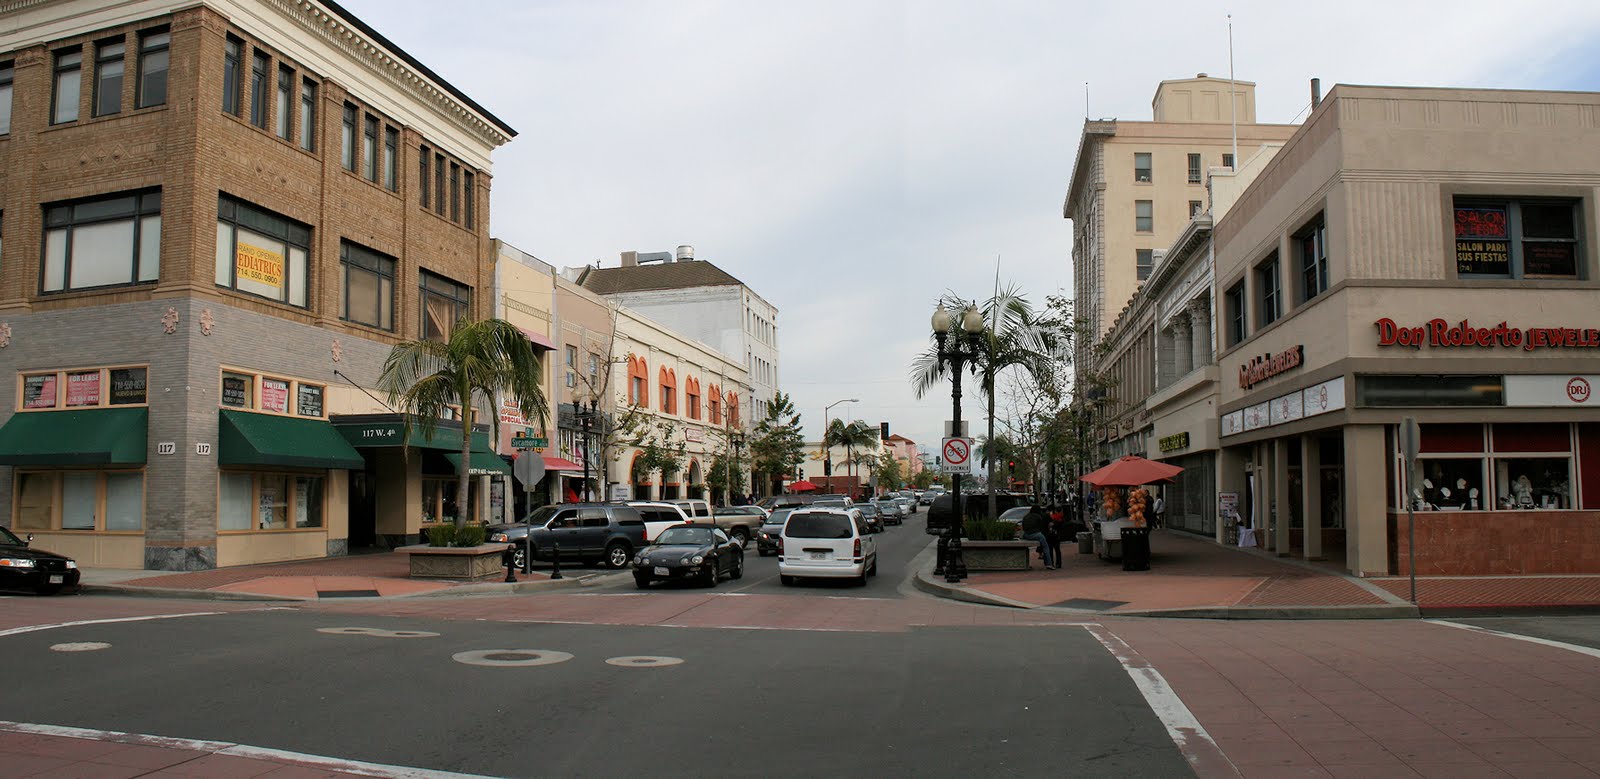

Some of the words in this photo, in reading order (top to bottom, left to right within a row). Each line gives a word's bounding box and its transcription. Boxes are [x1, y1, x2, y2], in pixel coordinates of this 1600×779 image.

[1457, 210, 1506, 225] SALON
[1457, 242, 1483, 251] SALON
[1486, 243, 1507, 252] PARA
[238, 244, 255, 256] RAND
[256, 250, 281, 264] OPENING
[1458, 252, 1473, 262] SUS
[1475, 252, 1508, 262] FIESTAS
[238, 253, 282, 277] EDIATRICS
[1375, 317, 1425, 349] Don
[1426, 318, 1523, 347] Roberto
[1525, 326, 1600, 351] JEWELE
[81, 373, 99, 382] LEASE
[263, 381, 273, 389] FOR
[1570, 385, 1587, 395] DRJ
[501, 415, 521, 424] SPECIAL
[376, 429, 386, 437] W.
[512, 439, 537, 447] Sycamore
[160, 445, 173, 453] 117
[198, 445, 209, 453] 117
